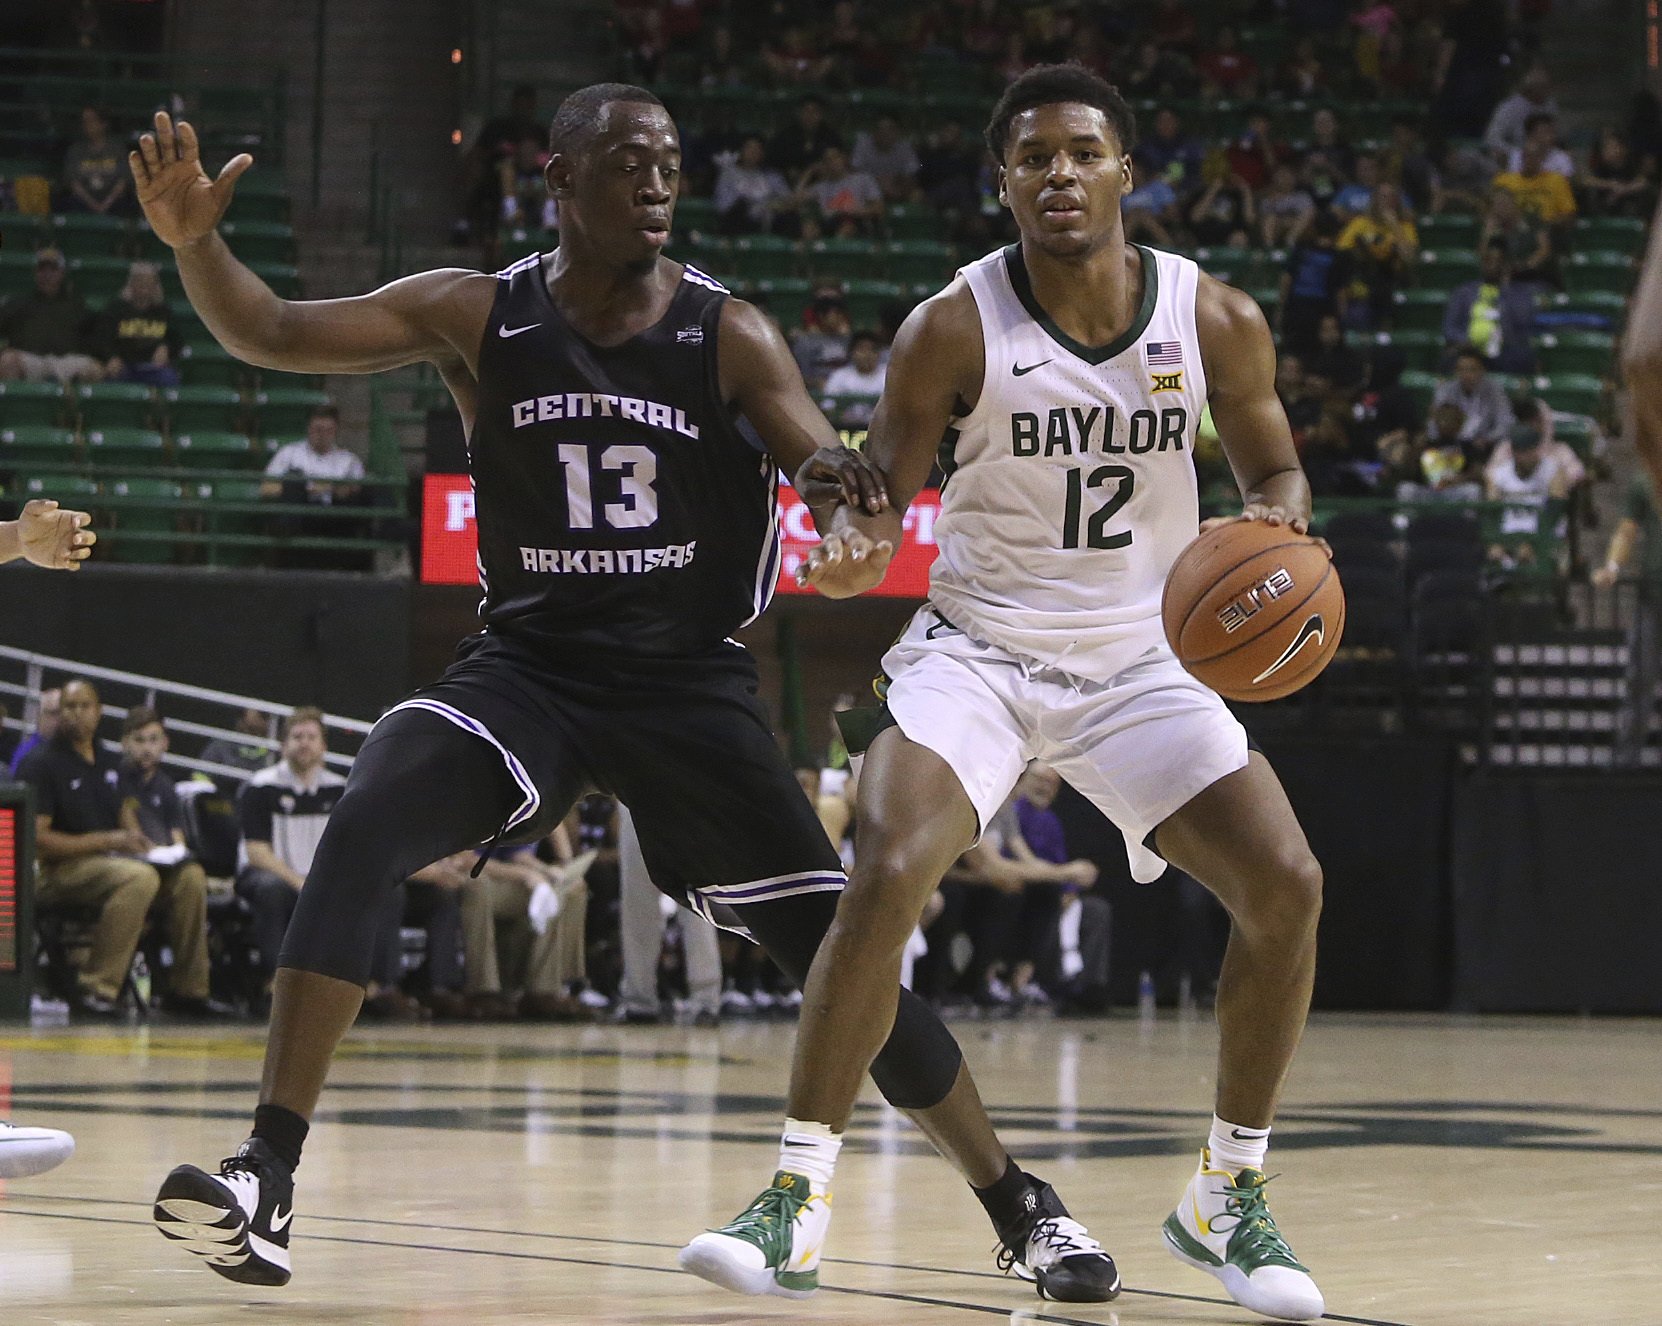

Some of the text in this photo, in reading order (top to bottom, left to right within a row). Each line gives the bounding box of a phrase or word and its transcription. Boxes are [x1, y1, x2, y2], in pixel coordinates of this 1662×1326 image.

[1151, 372, 1183, 392] XII
[511, 392, 700, 440] CENTRAL
[1011, 406, 1187, 457] BAYLOR
[557, 442, 659, 530] 13
[1062, 465, 1135, 549] 12
[519, 540, 697, 574] ARKANSAS
[1216, 567, 1295, 634] ELITE
